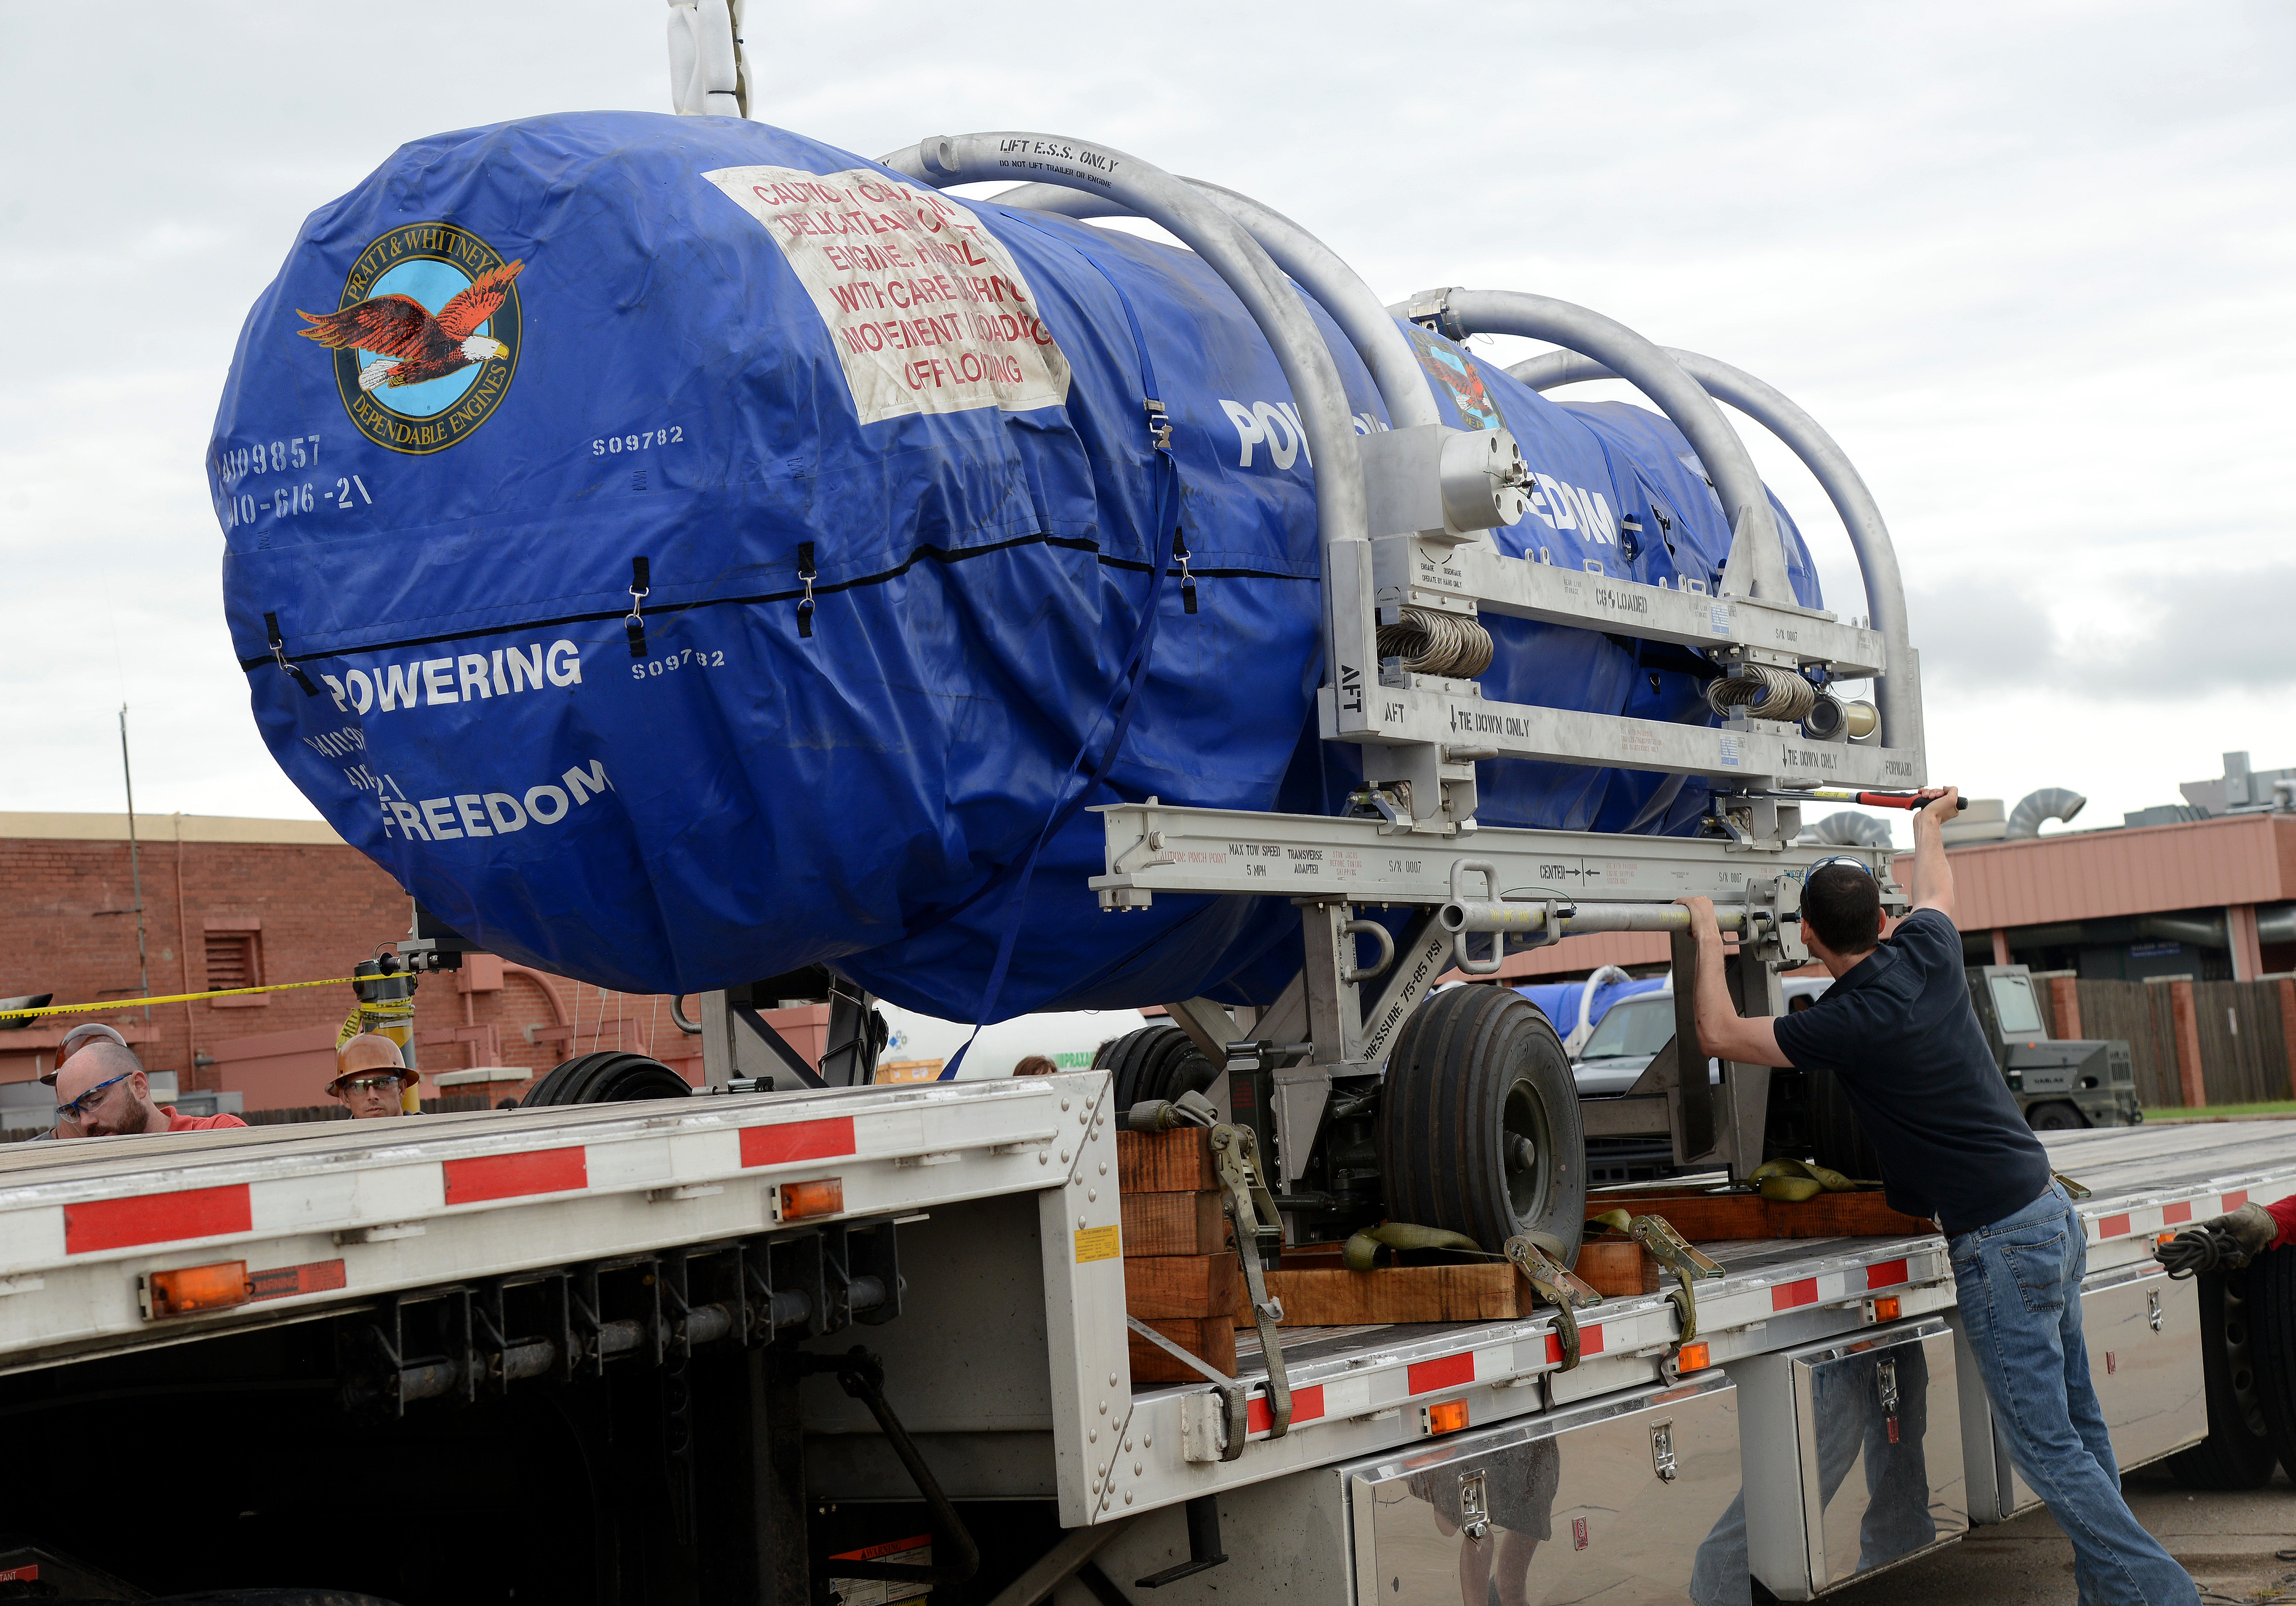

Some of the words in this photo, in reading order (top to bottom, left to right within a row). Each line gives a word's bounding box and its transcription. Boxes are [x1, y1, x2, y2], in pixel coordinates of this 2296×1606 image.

[1000, 139, 1030, 153] LIFT
[1034, 141, 1073, 160] E.S.S.
[1080, 151, 1119, 173] ONLY
[1028, 162, 1043, 170] LIFT
[1046, 163, 1074, 176] TRAILER
[1076, 170, 1086, 179] OR
[1087, 175, 1112, 188] ENGINE
[774, 210, 887, 237] DELICATE
[347, 243, 389, 301] PRATT
[390, 236, 402, 256] &
[404, 229, 496, 273] WHITNEY
[822, 244, 916, 271] ENGINE.
[887, 275, 958, 309] CARE
[842, 313, 963, 354] MOVEMENT
[352, 393, 448, 445] DEPENDABLE
[449, 363, 507, 435] ENGINES
[593, 426, 683, 455] S09782
[1420, 563, 1435, 572] ENGAGE
[1443, 568, 1462, 577] DISENGAGE
[1422, 574, 1437, 584] OPERATE
[1437, 577, 1442, 585] BY
[1443, 578, 1453, 586] HAND
[1595, 588, 1607, 607] CG
[1616, 591, 1648, 613] LOADED
[1787, 630, 1798, 642] 0007
[631, 647, 725, 680] S09782
[320, 640, 583, 715] POWERING
[1341, 664, 1362, 713] AFT
[1384, 702, 1404, 723] AFT
[1458, 711, 1473, 731] TIE
[1475, 713, 1503, 735] DOWN
[1506, 717, 1529, 738] ONLY
[1788, 749, 1798, 766] TIE
[1799, 751, 1819, 768] DOWN
[1821, 753, 1837, 769] ONLY
[1885, 760, 1912, 777] FORWARD
[380, 759, 615, 841] FREEDOM
[1188, 851, 1207, 863] PINCH
[1209, 852, 1227, 864] POINT
[1229, 843, 1244, 856] MAX
[1246, 844, 1260, 856] TOW
[1262, 845, 1280, 857] SPEED
[1287, 848, 1323, 861] TRANSVERSE
[1246, 864, 1252, 876] 5
[1253, 864, 1267, 877] MPH
[1294, 863, 1319, 875] ADAPTER
[1330, 860, 1345, 868] BEFORE
[1336, 868, 1357, 876] SHIPPING
[1389, 860, 1402, 873] S/N
[1405, 861, 1422, 874] 0007
[1539, 864, 1566, 880] CENTER
[1730, 872, 1742, 884] 0007
[1363, 1001, 1403, 1060] PRESSURE
[1400, 961, 1428, 1003] 75-85
[1425, 939, 1443, 964] PSI
[866, 1541, 902, 1556] WARNING
